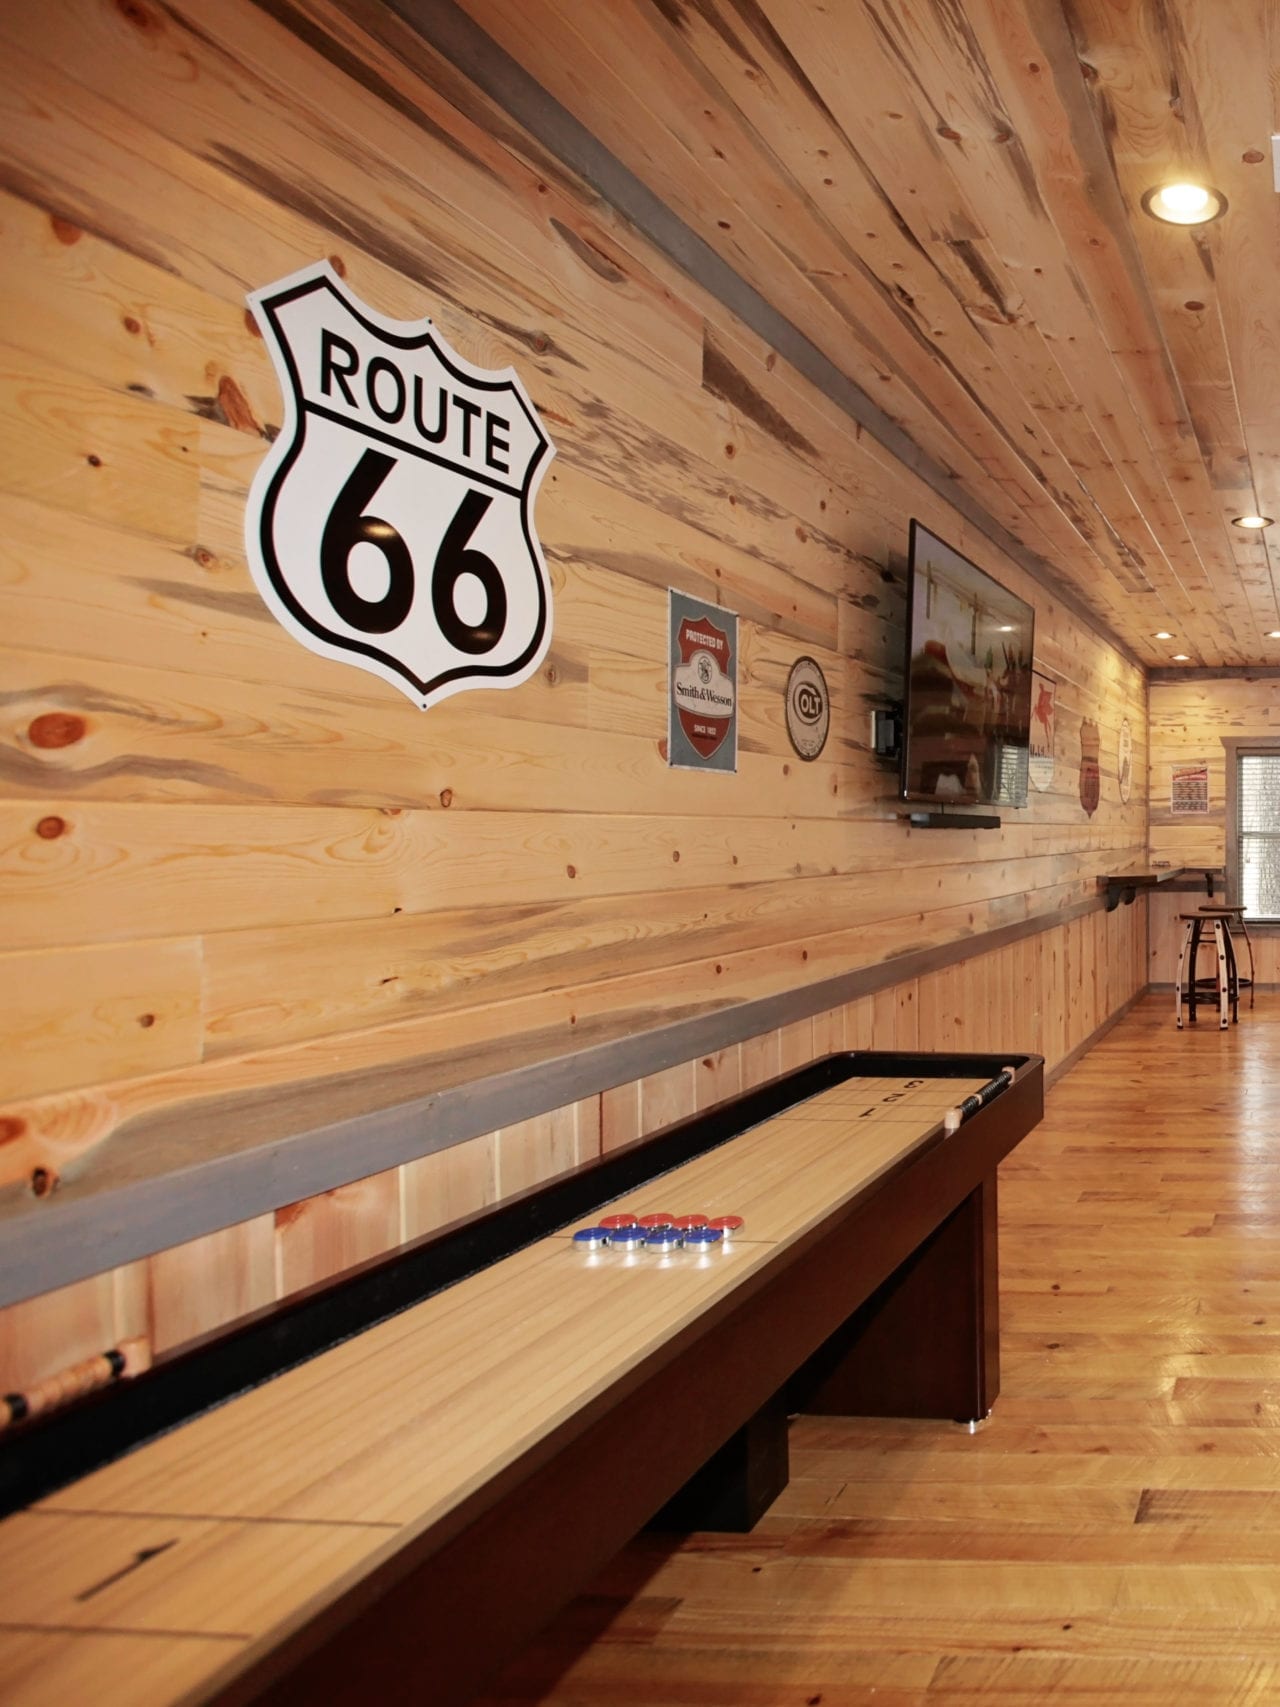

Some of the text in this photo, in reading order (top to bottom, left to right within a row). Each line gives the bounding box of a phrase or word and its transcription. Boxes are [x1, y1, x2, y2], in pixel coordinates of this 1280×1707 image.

[321, 328, 510, 474] ROUTE
[320, 447, 507, 655] 66
[686, 629, 715, 648] PROTECTED
[904, 1080, 924, 1088] 3
[882, 1094, 906, 1102] 2
[858, 1108, 876, 1117] 1
[73, 1537, 181, 1604] 1
